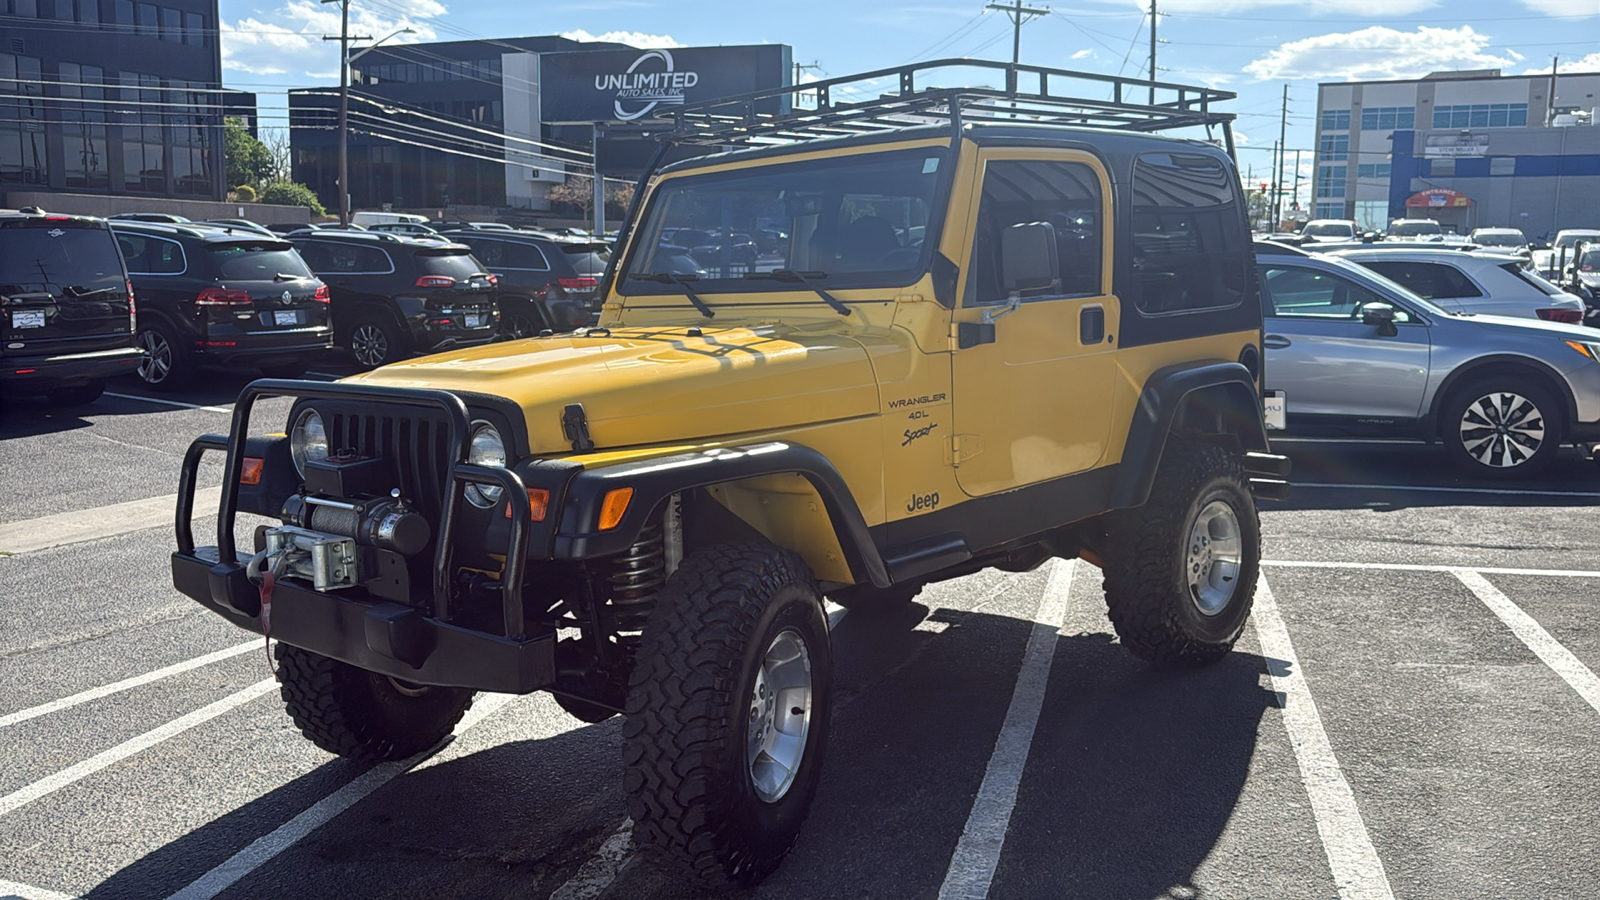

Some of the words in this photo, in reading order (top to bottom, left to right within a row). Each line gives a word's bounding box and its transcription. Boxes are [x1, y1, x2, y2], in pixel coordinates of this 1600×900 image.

[595, 72, 698, 90] UNLIMITED
[616, 89, 640, 98] AUTO
[1421, 188, 1456, 196] ENTRANCE
[888, 393, 946, 408] WRANGLER
[901, 422, 938, 447] Sport
[907, 492, 939, 512] Jeep
